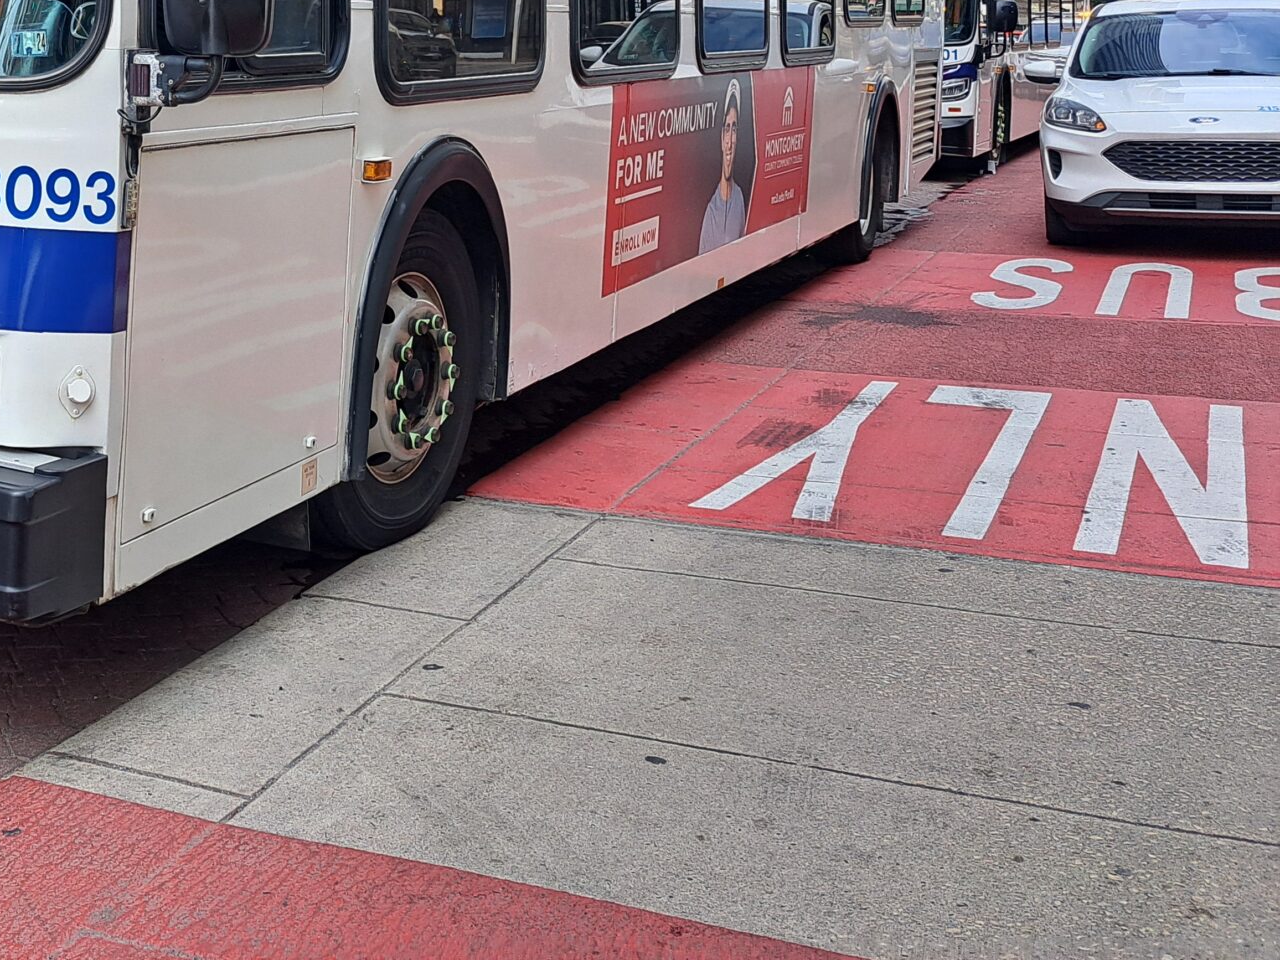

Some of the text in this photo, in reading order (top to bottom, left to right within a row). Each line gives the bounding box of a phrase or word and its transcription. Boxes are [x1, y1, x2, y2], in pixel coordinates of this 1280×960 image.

[617, 101, 718, 147] A NEW COMMUNITY
[765, 132, 806, 159] MONTGOMERY
[615, 149, 665, 190] FOR ME
[614, 227, 657, 257] ENROLL NOW
